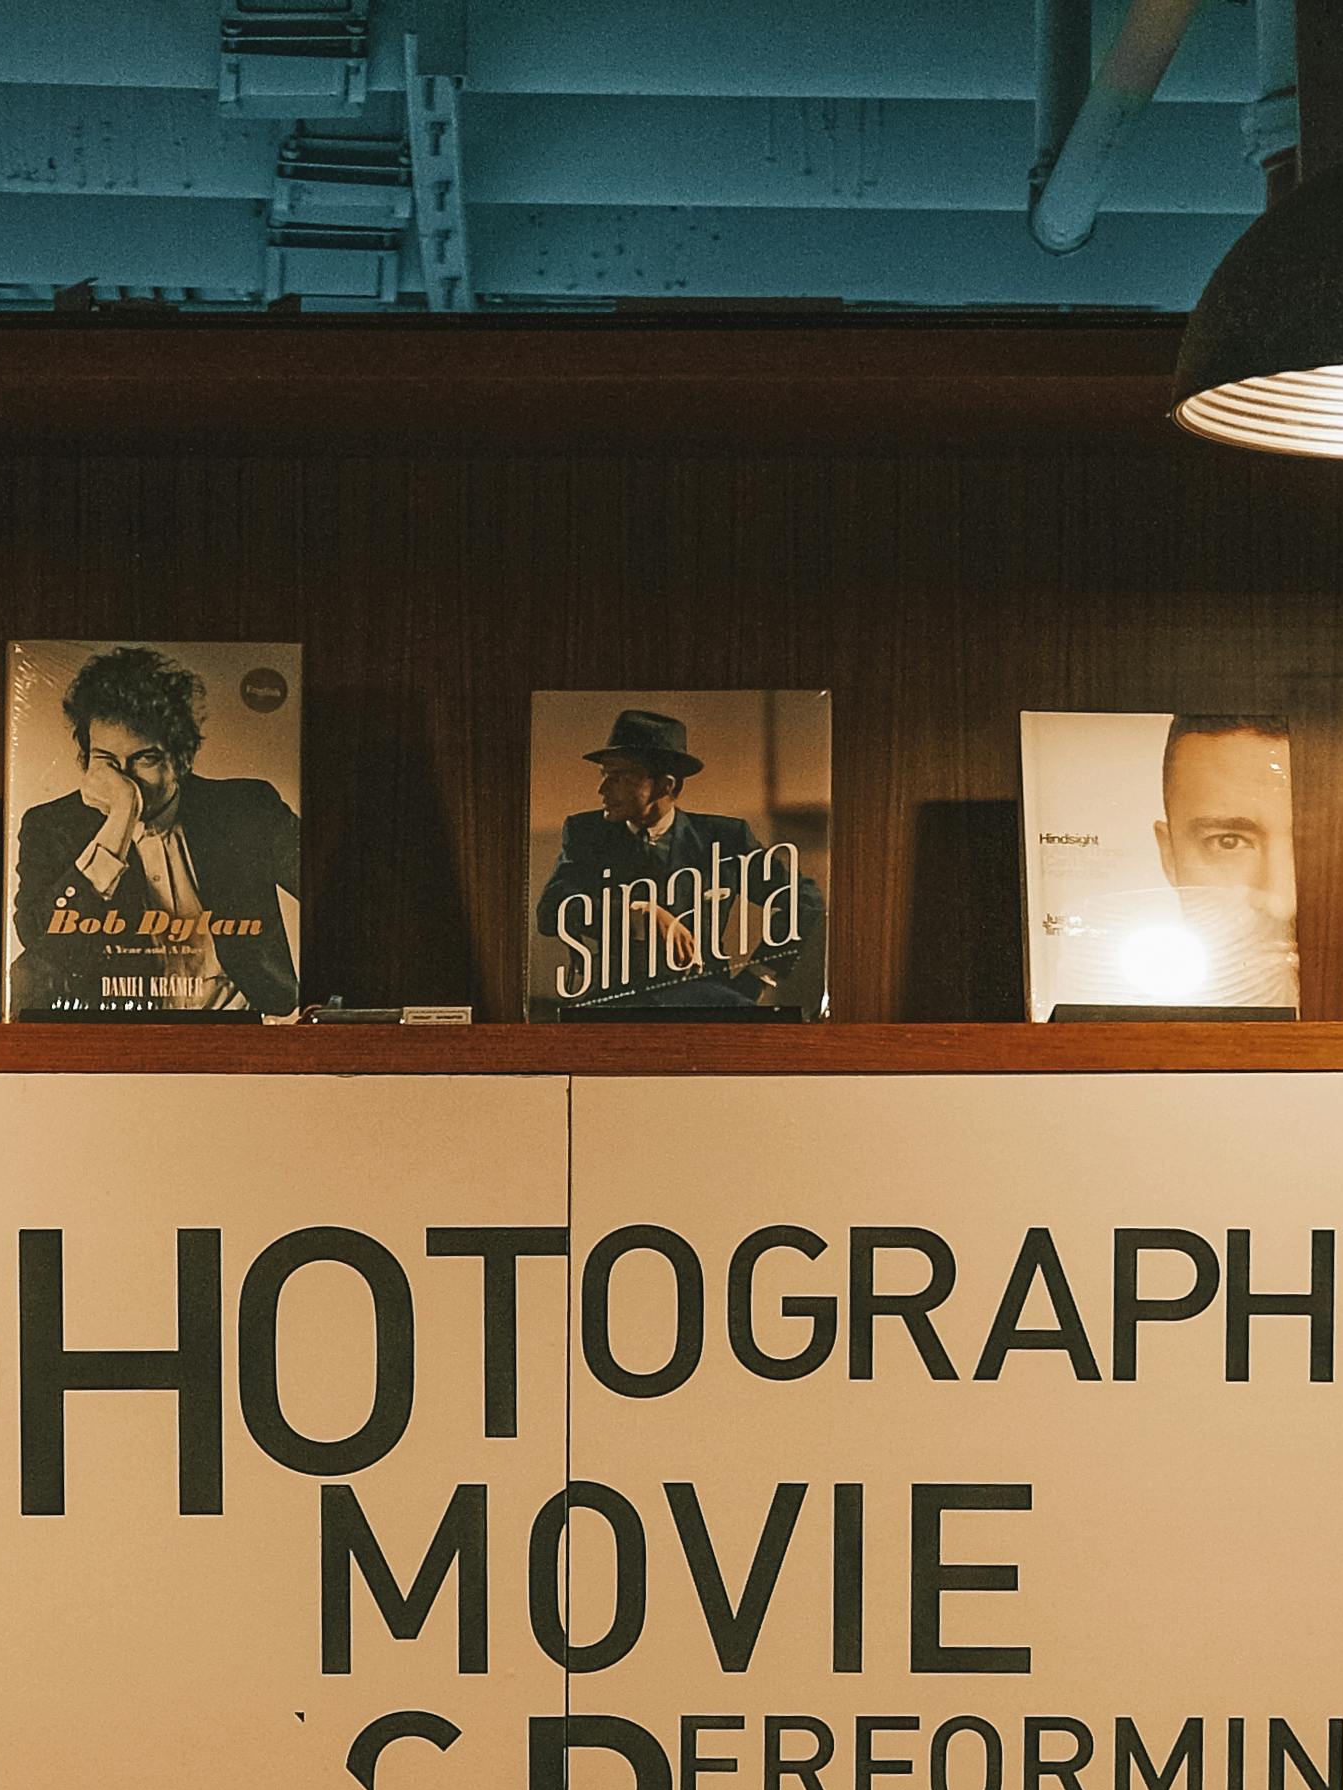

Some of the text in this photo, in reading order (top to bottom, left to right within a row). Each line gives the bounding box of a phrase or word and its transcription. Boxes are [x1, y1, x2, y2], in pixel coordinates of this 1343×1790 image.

[1039, 833, 1099, 847] Hindsight
[47, 910, 263, 942] Bob Dylan
[556, 841, 801, 999] sinatra
[101, 976, 204, 997] DANIEL KRAMER
[321, 1480, 1033, 1675] MOVIE
